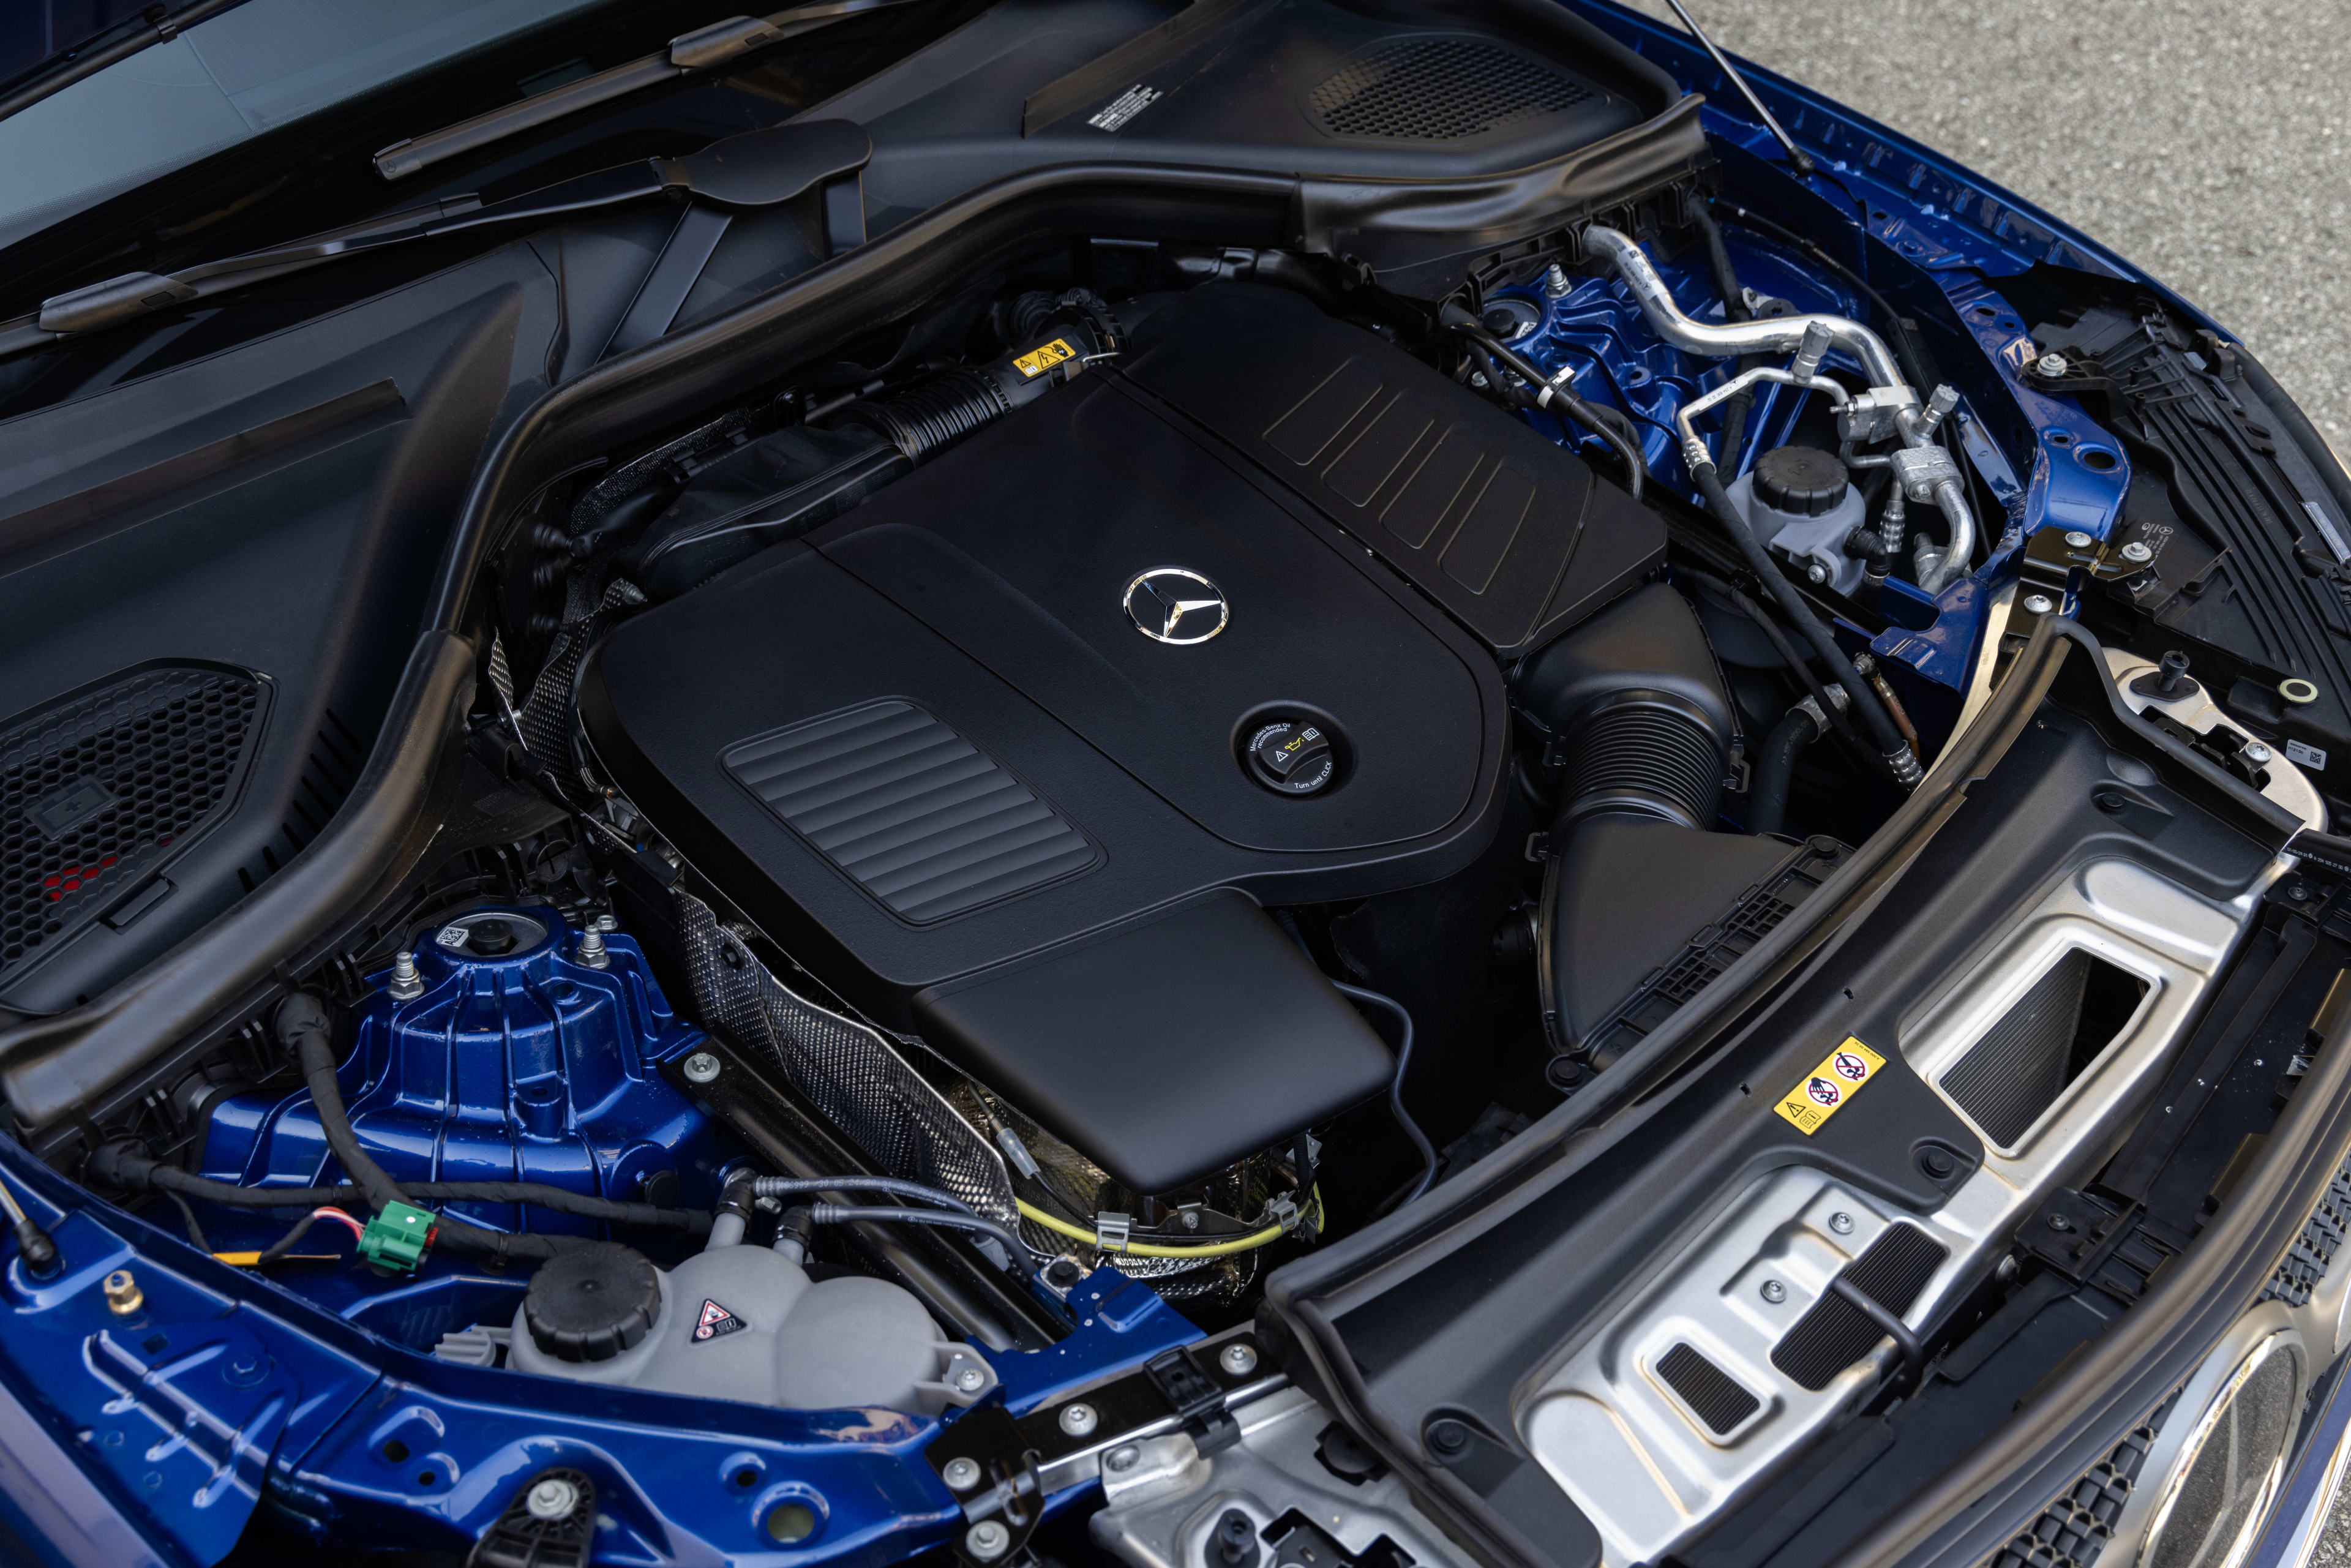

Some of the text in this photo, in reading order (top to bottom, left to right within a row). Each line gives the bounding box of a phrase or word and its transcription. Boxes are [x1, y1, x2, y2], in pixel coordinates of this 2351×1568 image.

[1250, 724, 1281, 752] Mercedes-Benz
[1258, 727, 1288, 749] recommended
[1311, 776, 1323, 786] until
[1322, 761, 1332, 777] CLICK
